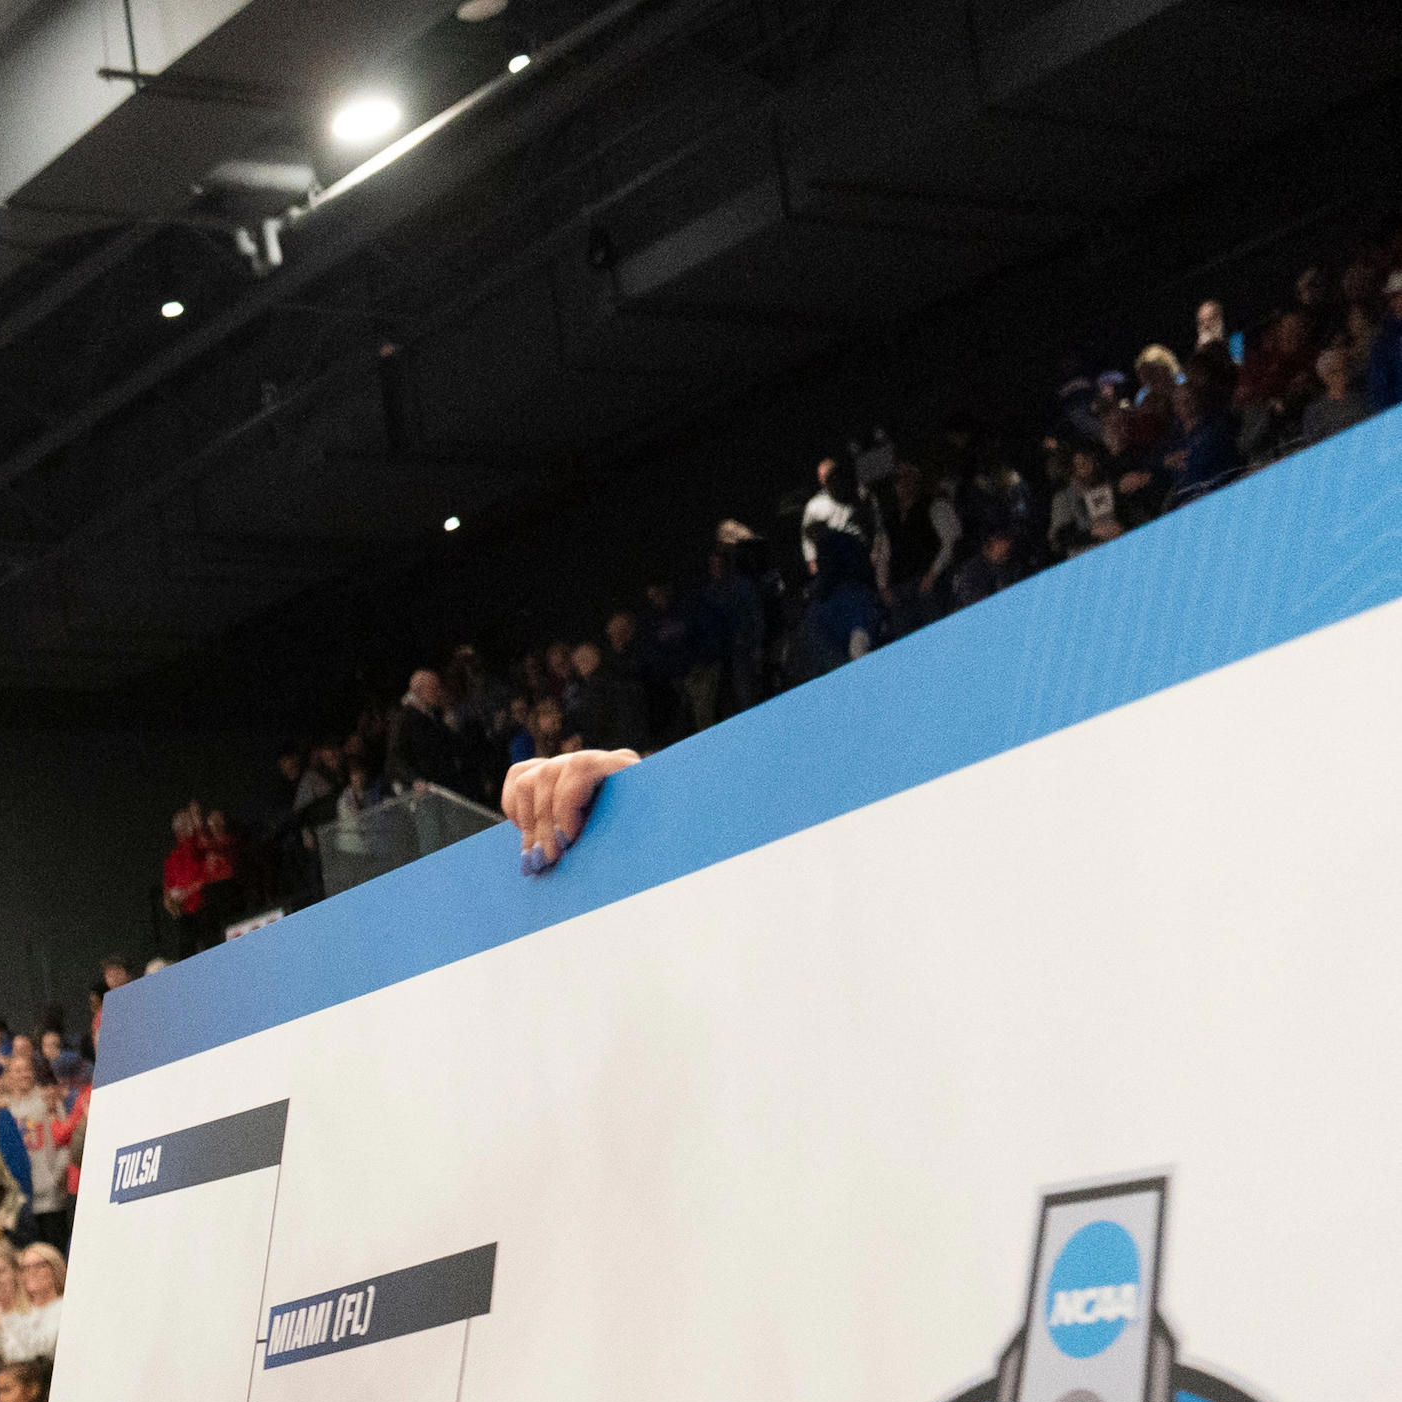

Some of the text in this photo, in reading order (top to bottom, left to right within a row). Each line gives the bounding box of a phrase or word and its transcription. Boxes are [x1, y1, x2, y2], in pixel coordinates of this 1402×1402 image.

[114, 1145, 162, 1192] TULSA
[267, 1284, 376, 1355] MIAMI (FL)
[1047, 1283, 1140, 1327] NCAA
